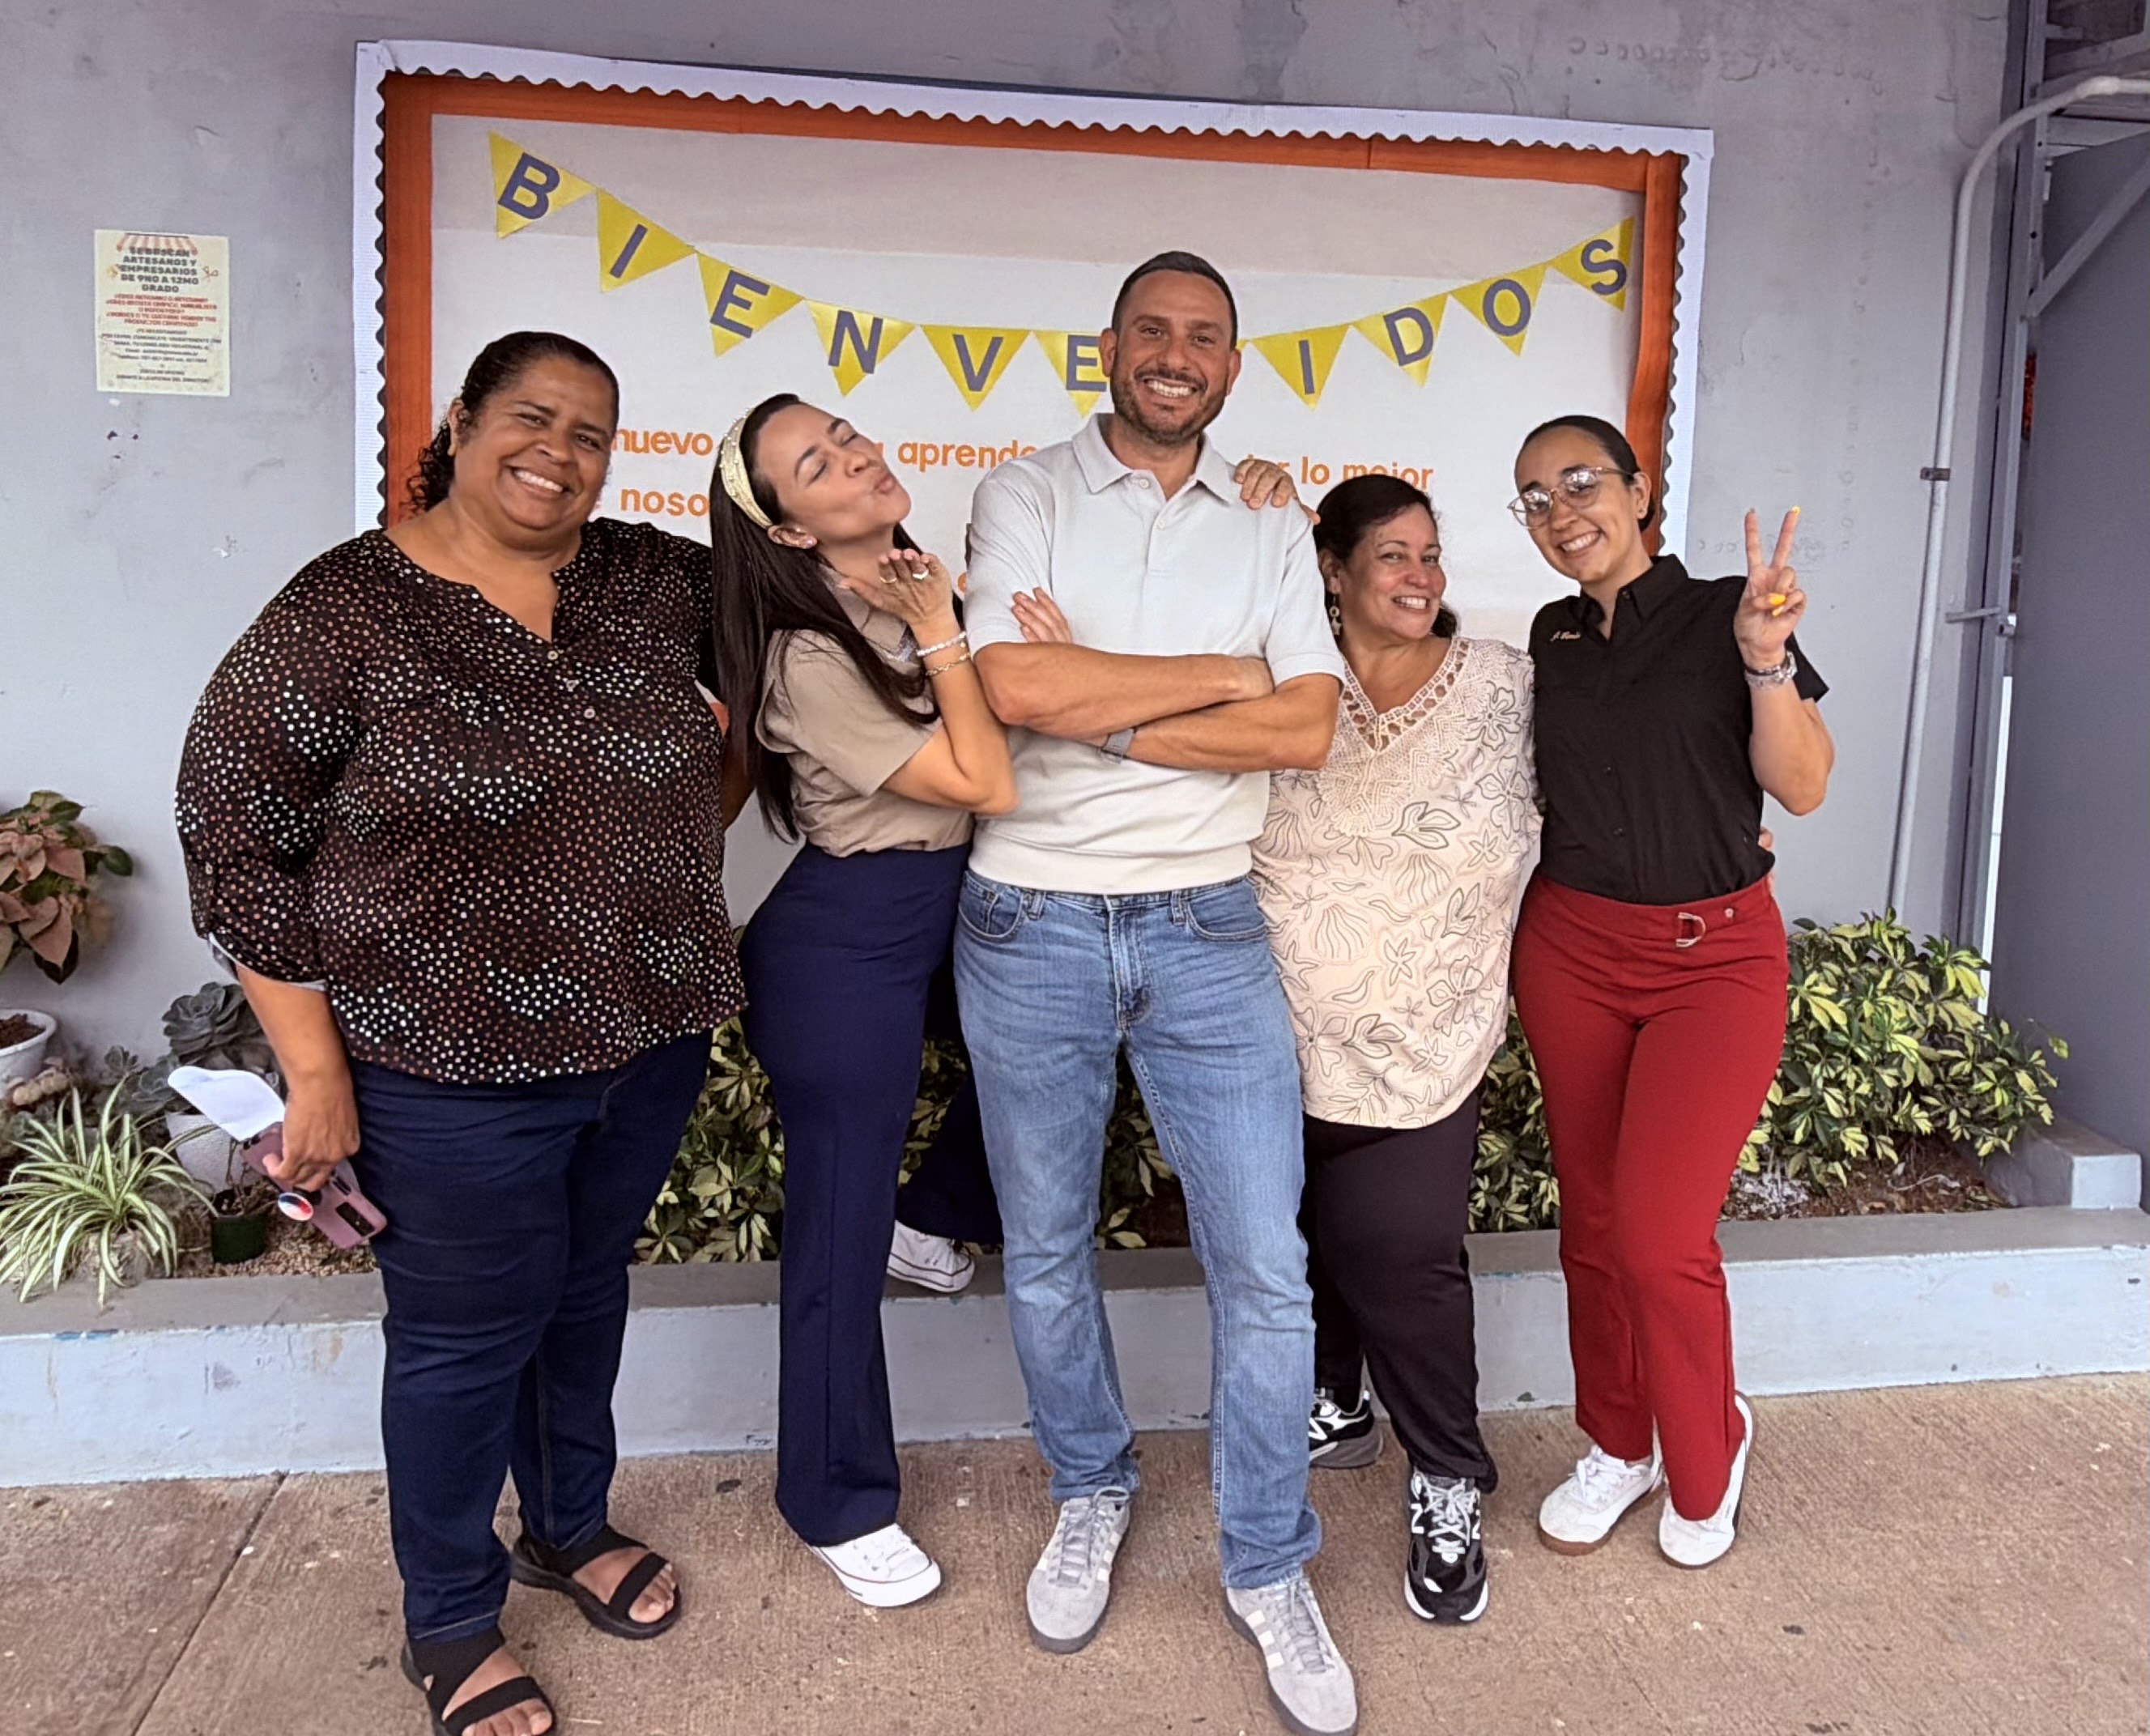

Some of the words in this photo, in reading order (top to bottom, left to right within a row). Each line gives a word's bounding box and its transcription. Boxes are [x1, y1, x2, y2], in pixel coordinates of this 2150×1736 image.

[121, 265, 197, 275] EMPRESARIOS
[123, 256, 187, 266] ARTESANOS
[121, 274, 135, 282] DE
[137, 274, 159, 283] 9NO
[170, 276, 199, 285] 12MO
[498, 153, 1628, 394] BIENVEIDOS
[611, 428, 713, 456] nuevo
[1301, 456, 1330, 485] lo
[620, 488, 709, 517] noso
